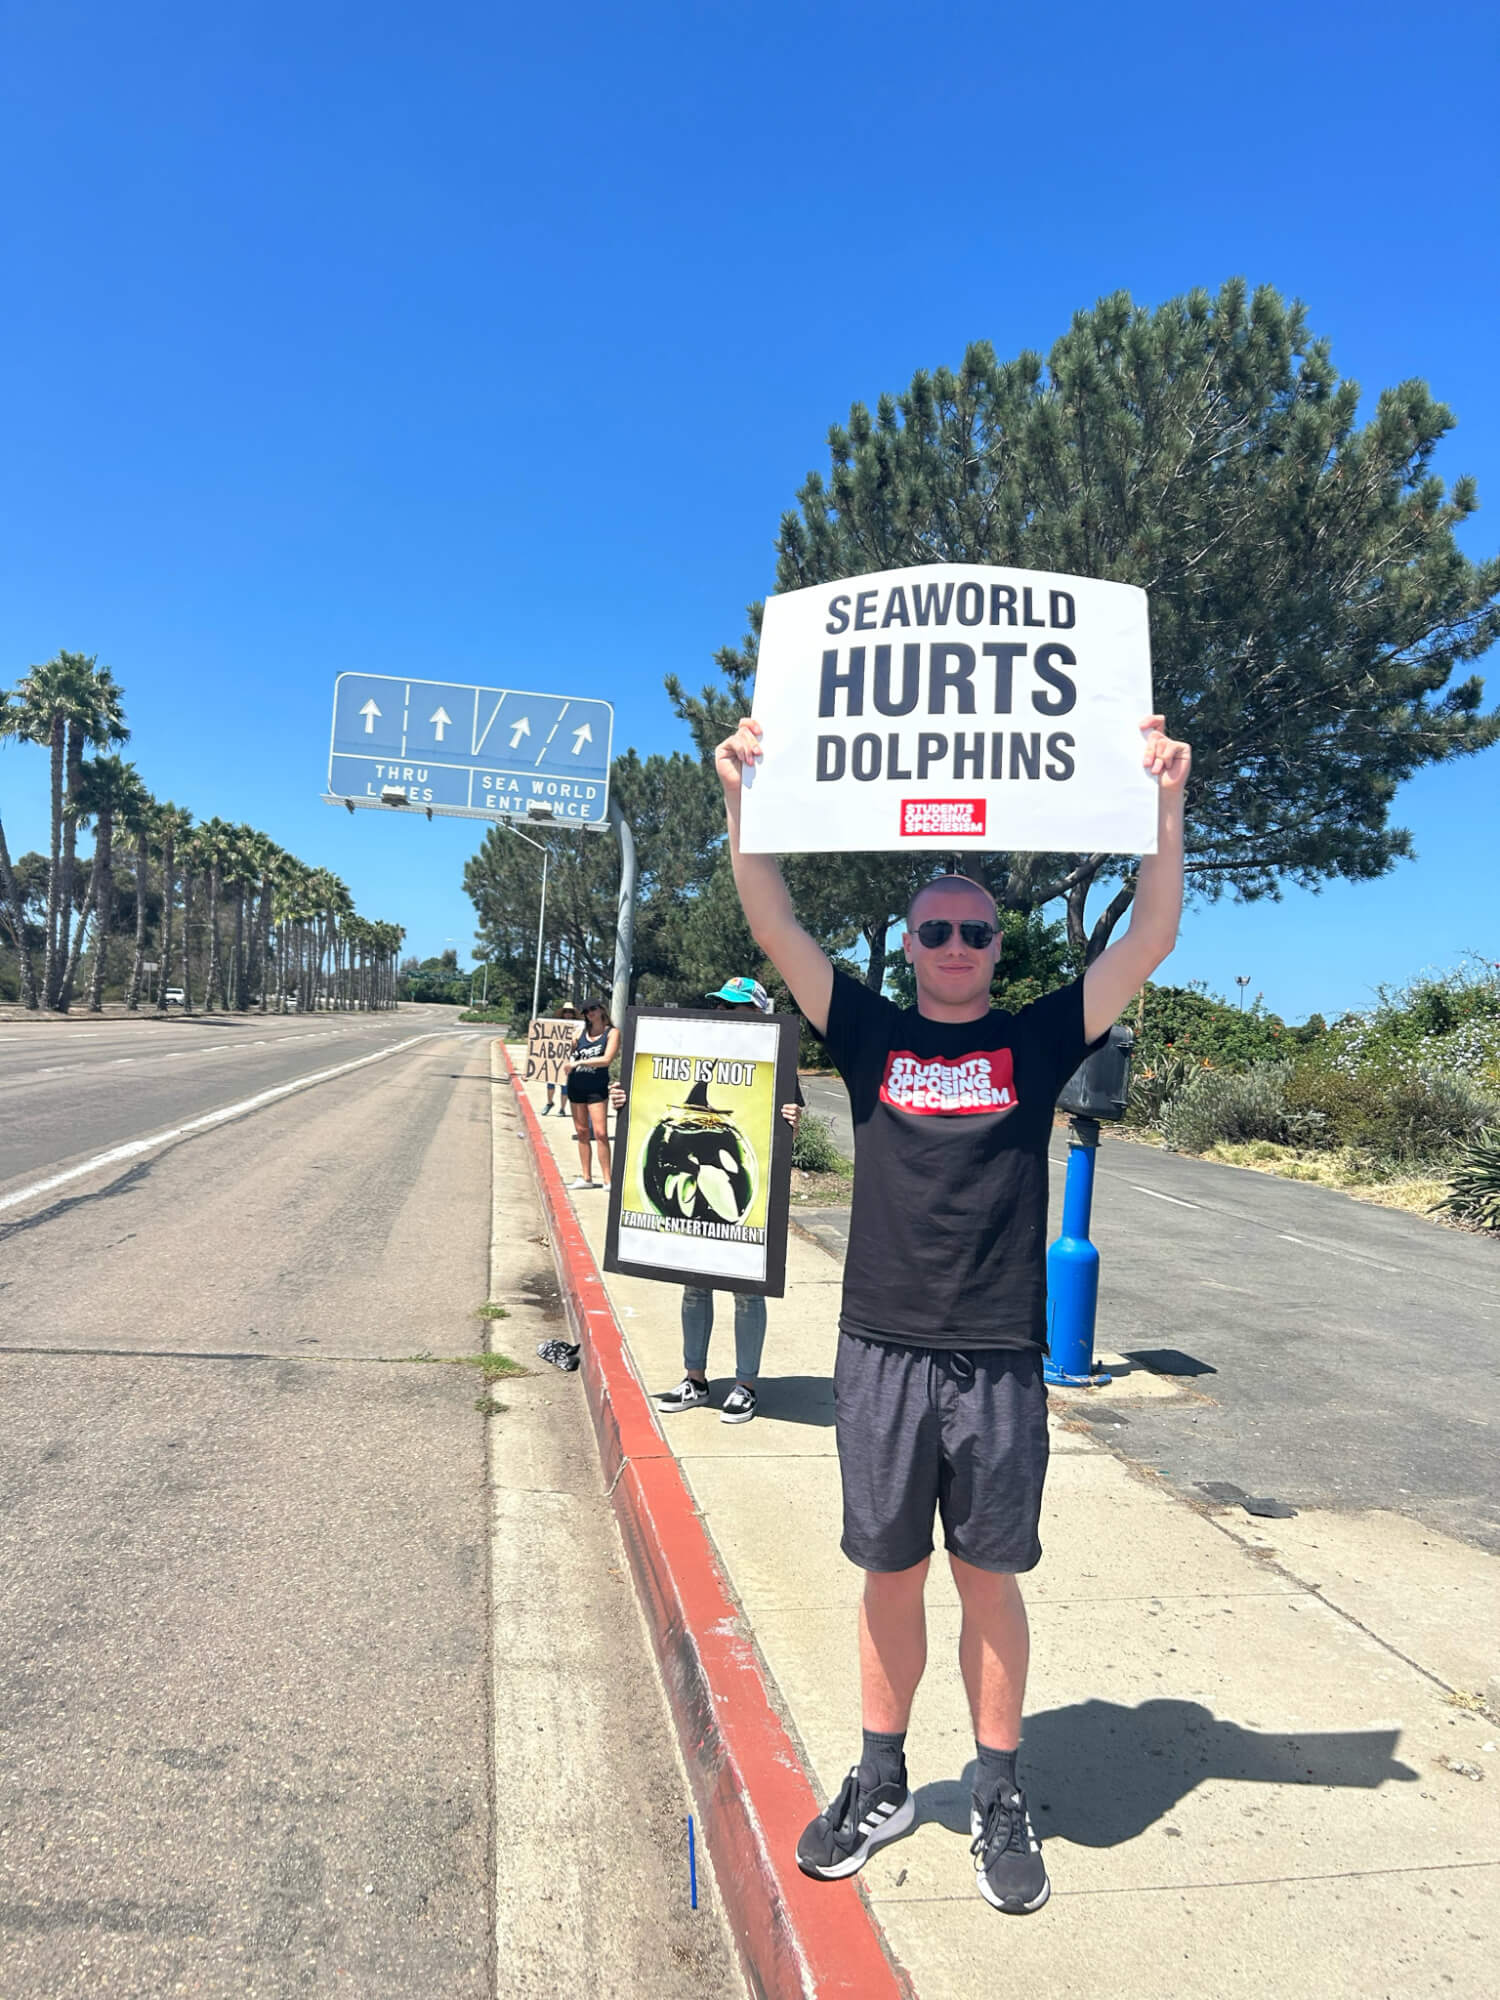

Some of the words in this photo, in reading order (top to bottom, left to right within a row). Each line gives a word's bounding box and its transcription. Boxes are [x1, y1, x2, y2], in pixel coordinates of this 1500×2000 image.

[825, 581, 1076, 635] SEAWORLD
[818, 642, 1077, 718] HURTS
[816, 731, 1075, 782] DOLPHINS
[375, 764, 429, 783] THRU
[367, 782, 433, 802] LES
[482, 775, 519, 793] SEA
[532, 780, 597, 800] WORLD
[486, 795, 591, 818] ENTRNCE
[904, 813, 972, 823] OPPOSING
[905, 803, 974, 814] STUDENTS
[905, 822, 983, 833] SPECIESISM
[530, 1022, 574, 1040] SLAVE
[530, 1041, 571, 1060] LABOR
[526, 1059, 564, 1083] DAY
[652, 1056, 691, 1081] THIS
[694, 1059, 713, 1083] IS
[717, 1061, 756, 1086] NOT
[891, 1057, 992, 1080] STUDENTS
[888, 1073, 991, 1096] OPPOSING
[888, 1087, 1010, 1110] SPECIESISM
